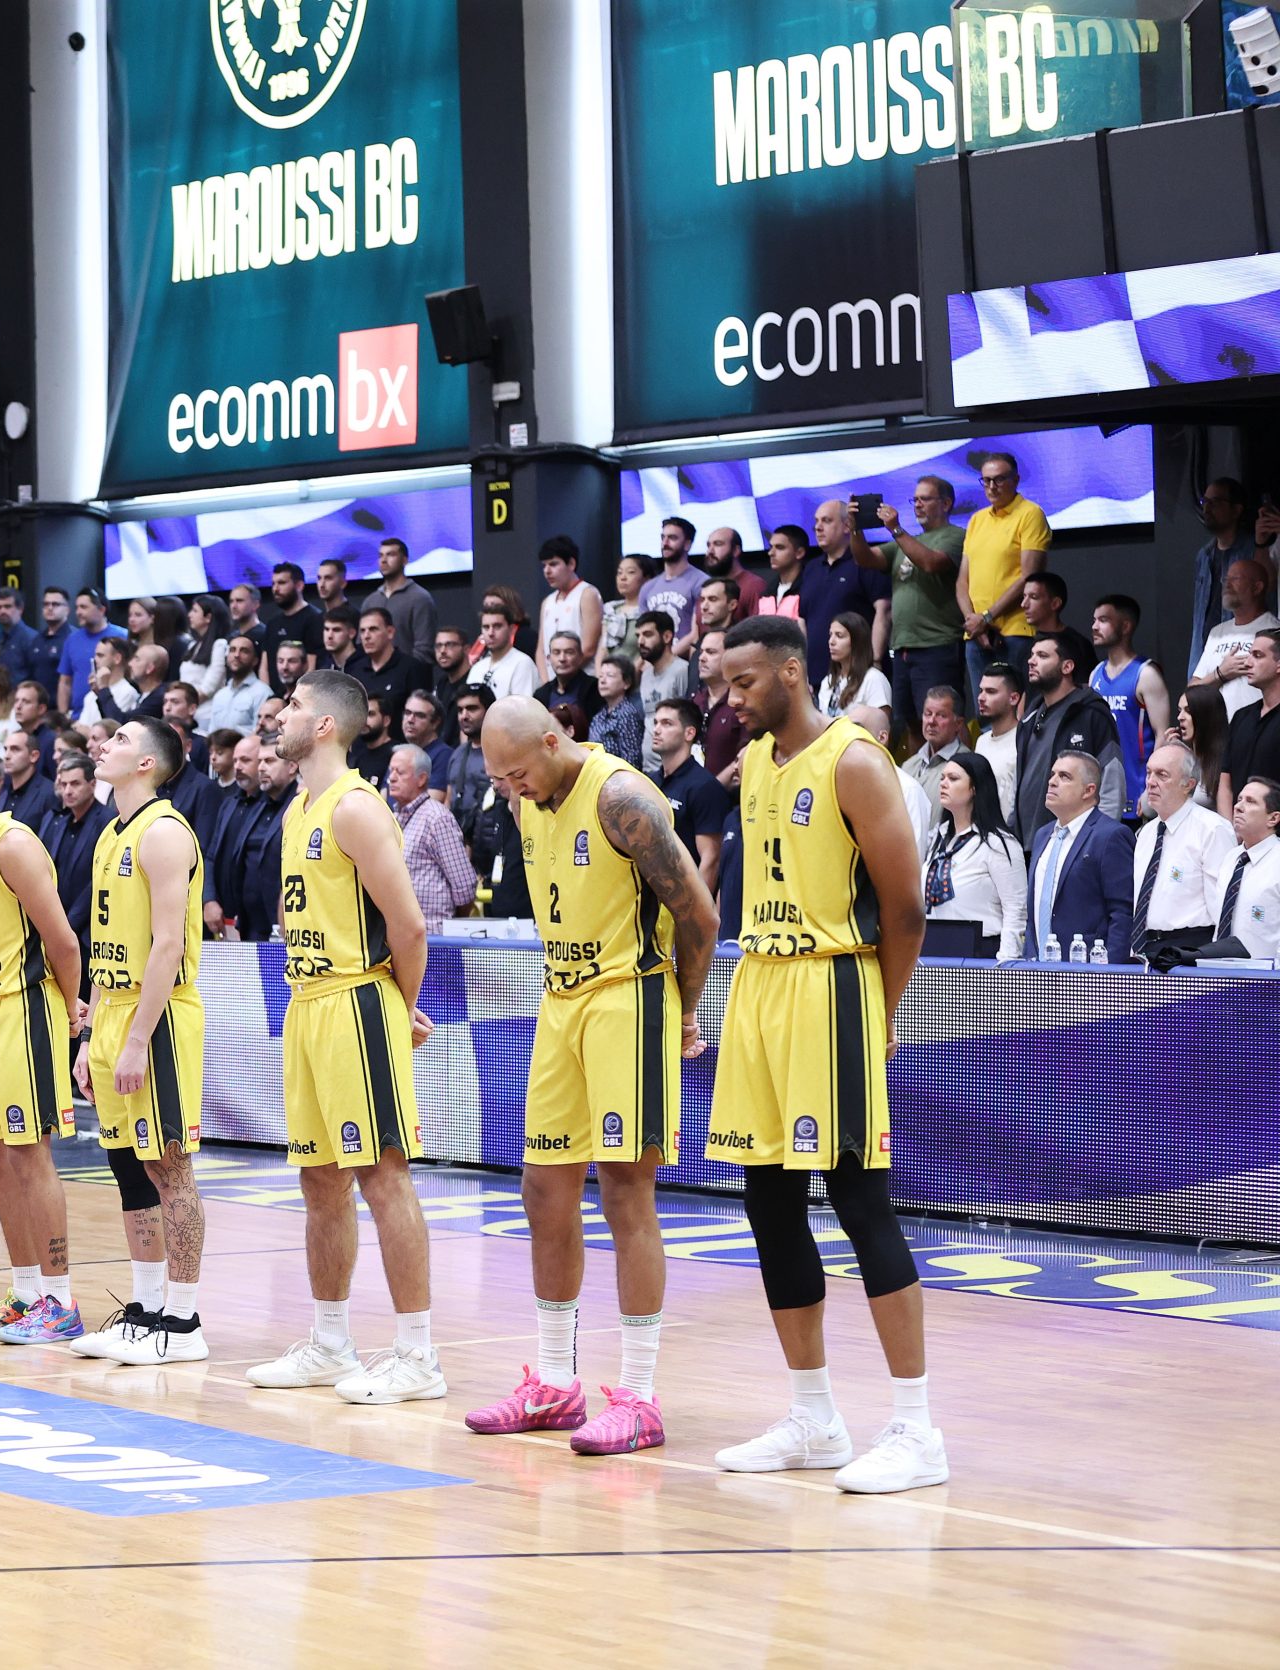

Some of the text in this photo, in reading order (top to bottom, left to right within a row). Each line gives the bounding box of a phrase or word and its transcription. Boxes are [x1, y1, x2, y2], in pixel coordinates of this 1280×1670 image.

[713, 4, 1059, 187] MAROUSSI BC
[171, 137, 419, 284] MAROUSSI BC
[492, 498, 508, 526] D
[284, 874, 307, 913] 23
[549, 882, 562, 924] 2
[98, 889, 110, 926] 5
[544, 940, 602, 962] ROUSSI
[288, 1139, 317, 1155] vibet
[343, 1144, 361, 1153] GBL
[526, 1133, 571, 1150] ovibet
[603, 1137, 622, 1147] GBL
[707, 1130, 755, 1150] ovibet
[794, 1142, 818, 1152] GBL
